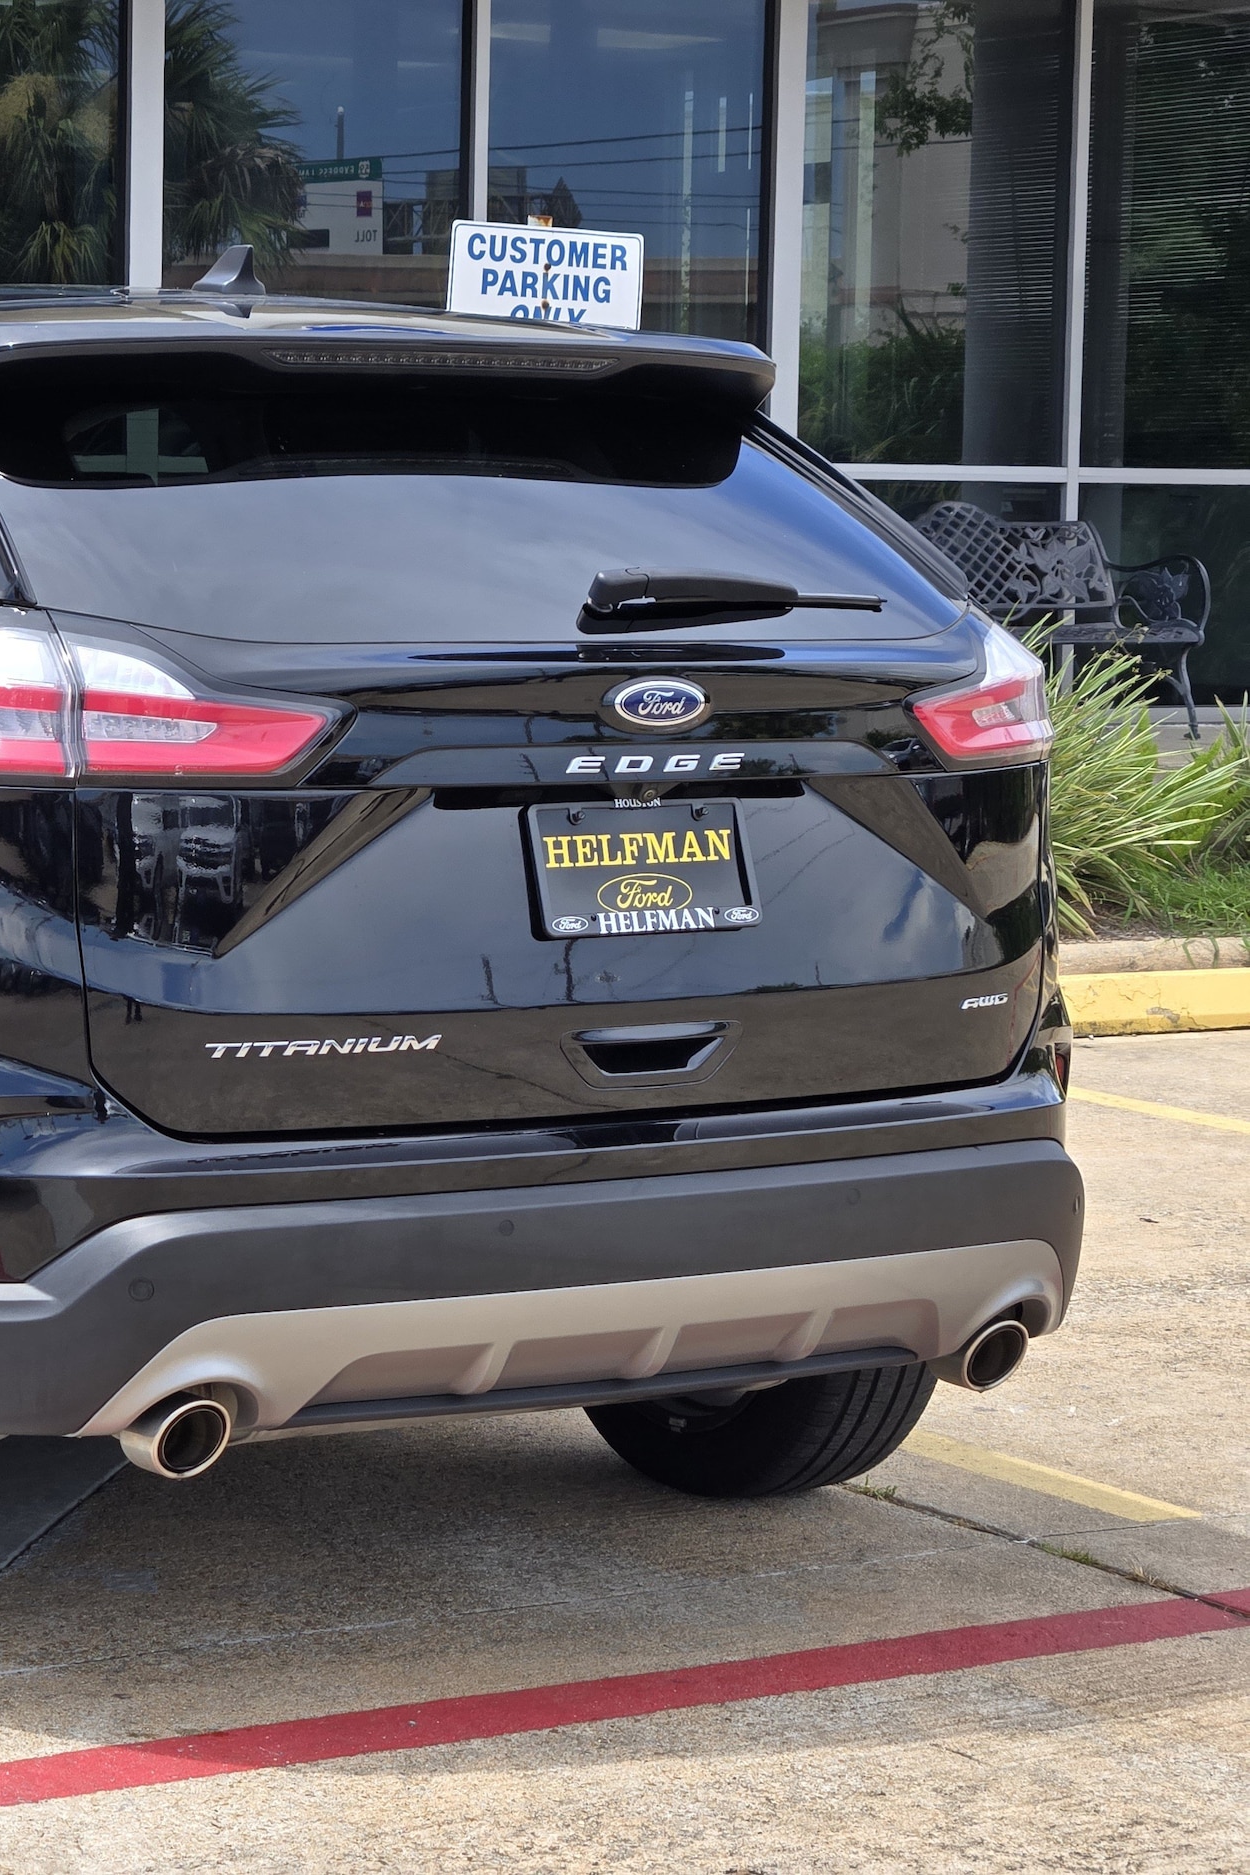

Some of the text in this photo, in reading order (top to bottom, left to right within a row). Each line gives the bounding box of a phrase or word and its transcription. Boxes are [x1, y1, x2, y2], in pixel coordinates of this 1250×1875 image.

[467, 233, 628, 271] CUSTOMER
[481, 268, 611, 303] PARKING
[638, 690, 685, 715] Ford
[565, 752, 745, 774] EDGE
[614, 797, 661, 808] HOUSON
[543, 829, 731, 868] HELFMAN
[616, 879, 674, 909] Ford
[558, 906, 754, 934] Ford HELFMAN Ford
[960, 993, 1008, 1010] AWD
[205, 1034, 442, 1059] TITANIUM
